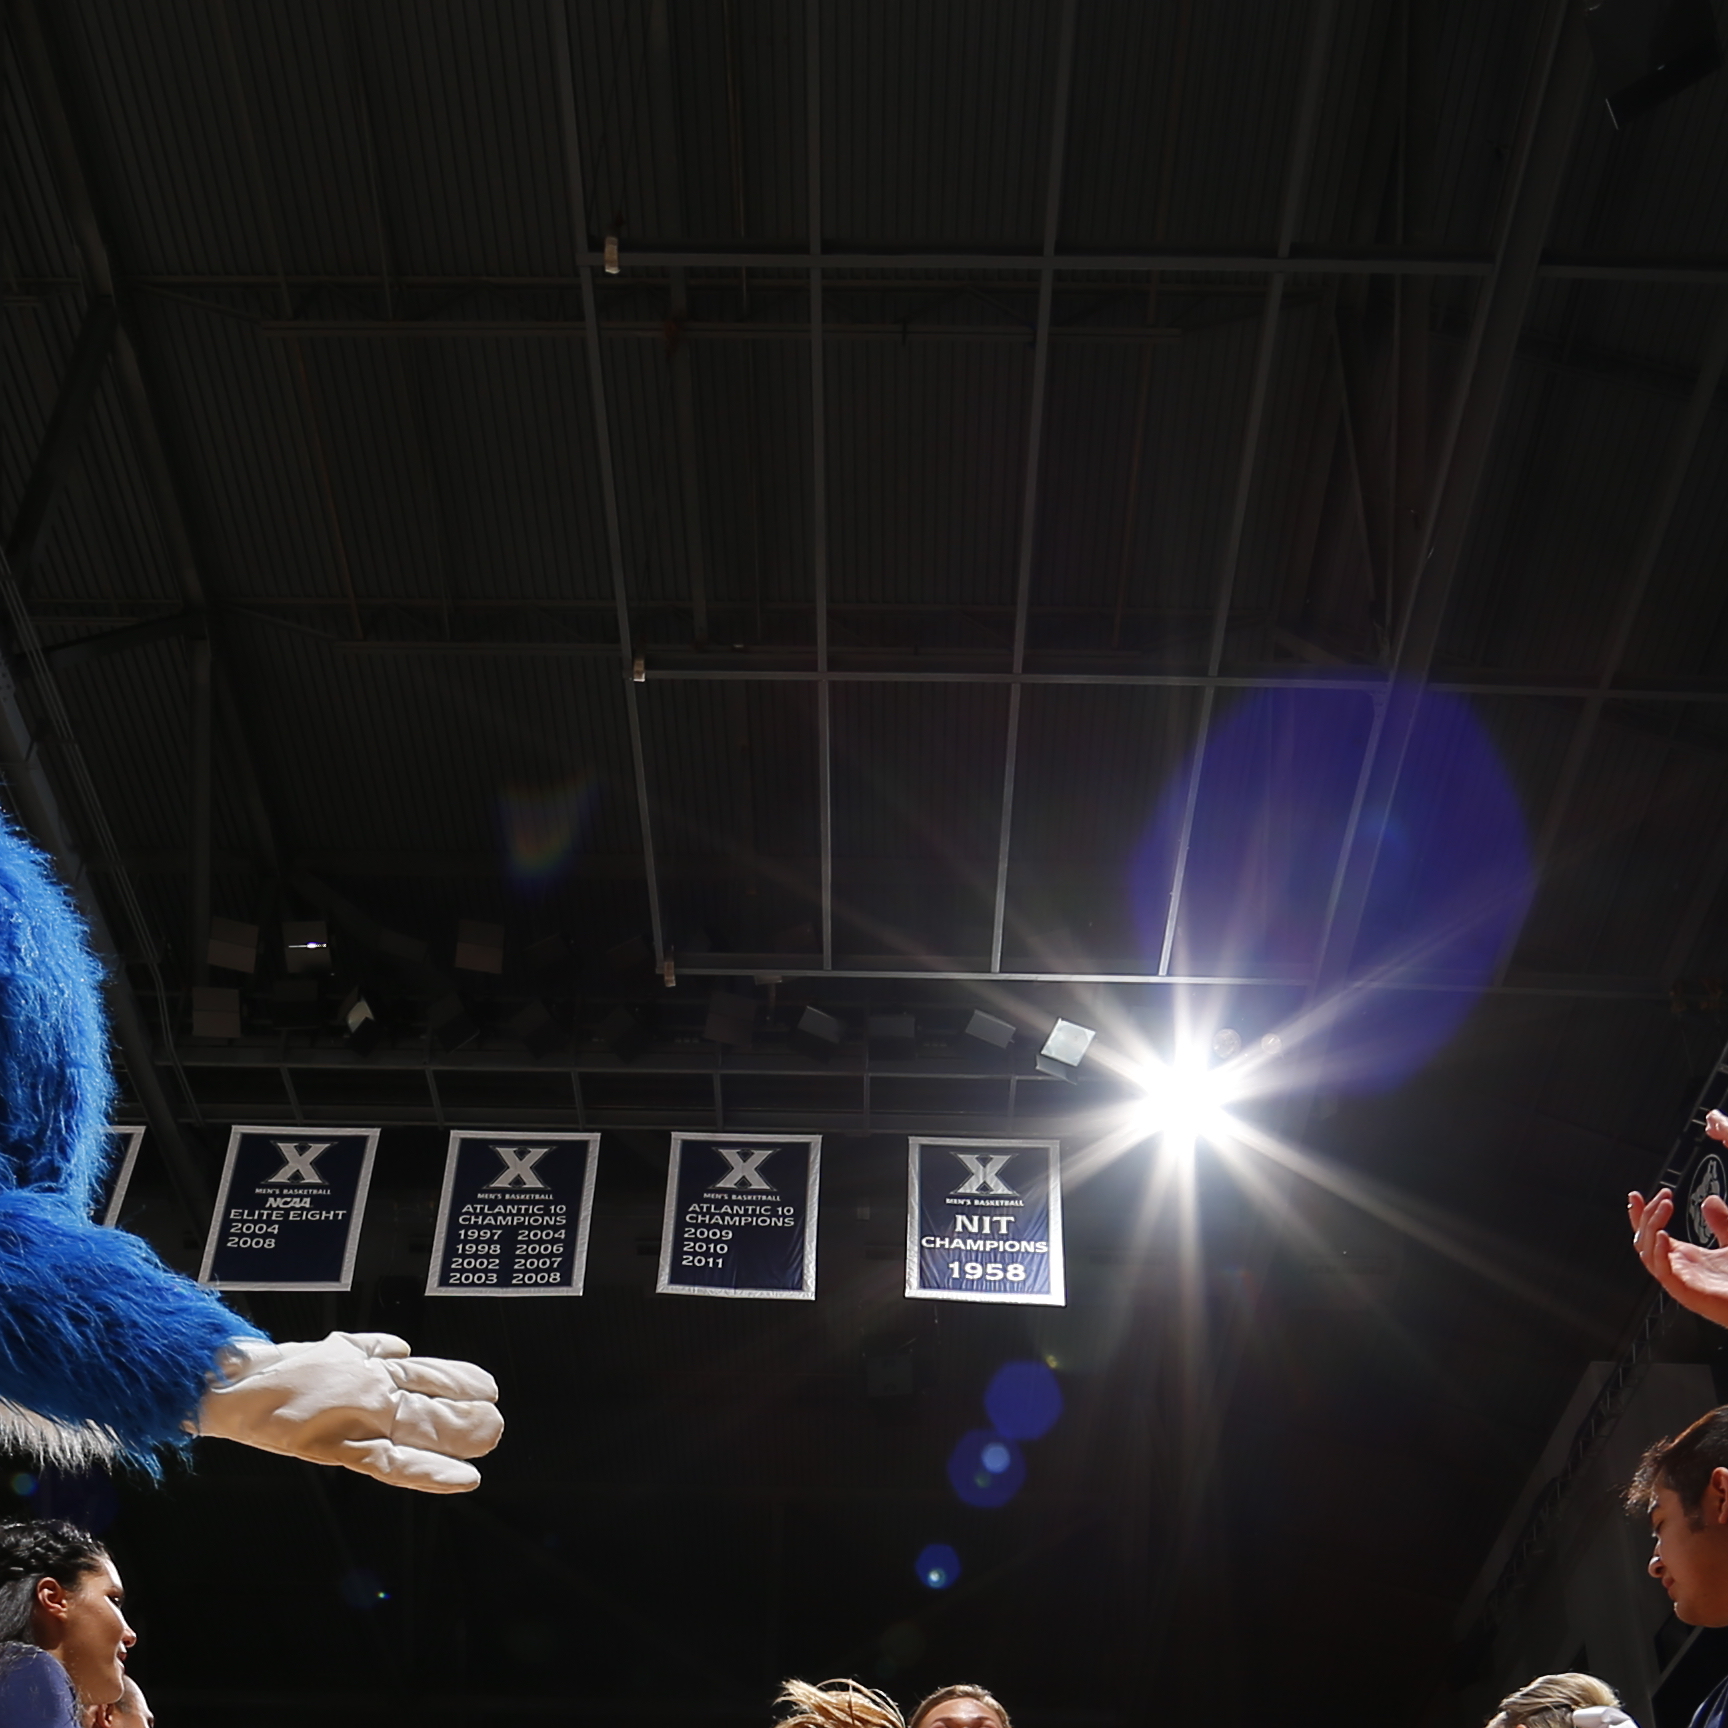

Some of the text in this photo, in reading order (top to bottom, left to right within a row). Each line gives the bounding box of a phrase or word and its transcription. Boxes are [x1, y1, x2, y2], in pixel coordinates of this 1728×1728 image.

[265, 1197, 312, 1208] NCAA
[703, 1192, 781, 1201] MEN'S BASKETBALL
[945, 1198, 1024, 1207] MEN'S BASKETBALL
[229, 1209, 348, 1221] ELITE EIGHT
[461, 1204, 567, 1214] ATLANTIC 10
[687, 1203, 794, 1216] ATLANTIC 10
[458, 1215, 567, 1226] CHAMPIONS
[685, 1213, 795, 1227] CHAMPIONS
[955, 1214, 1015, 1234] NIT
[229, 1222, 279, 1234] 2004
[683, 1227, 733, 1240] 2009
[458, 1229, 566, 1240] 1997 2004
[226, 1236, 276, 1249] 2008
[682, 1241, 728, 1254] 2010
[920, 1236, 1049, 1253] CHAMPIONS
[456, 1243, 564, 1255] 1998 2006
[450, 1257, 563, 1269] 2002 2007
[681, 1255, 723, 1268] 2011
[948, 1261, 1027, 1281] 1958
[448, 1271, 561, 1284] 2003 2008
